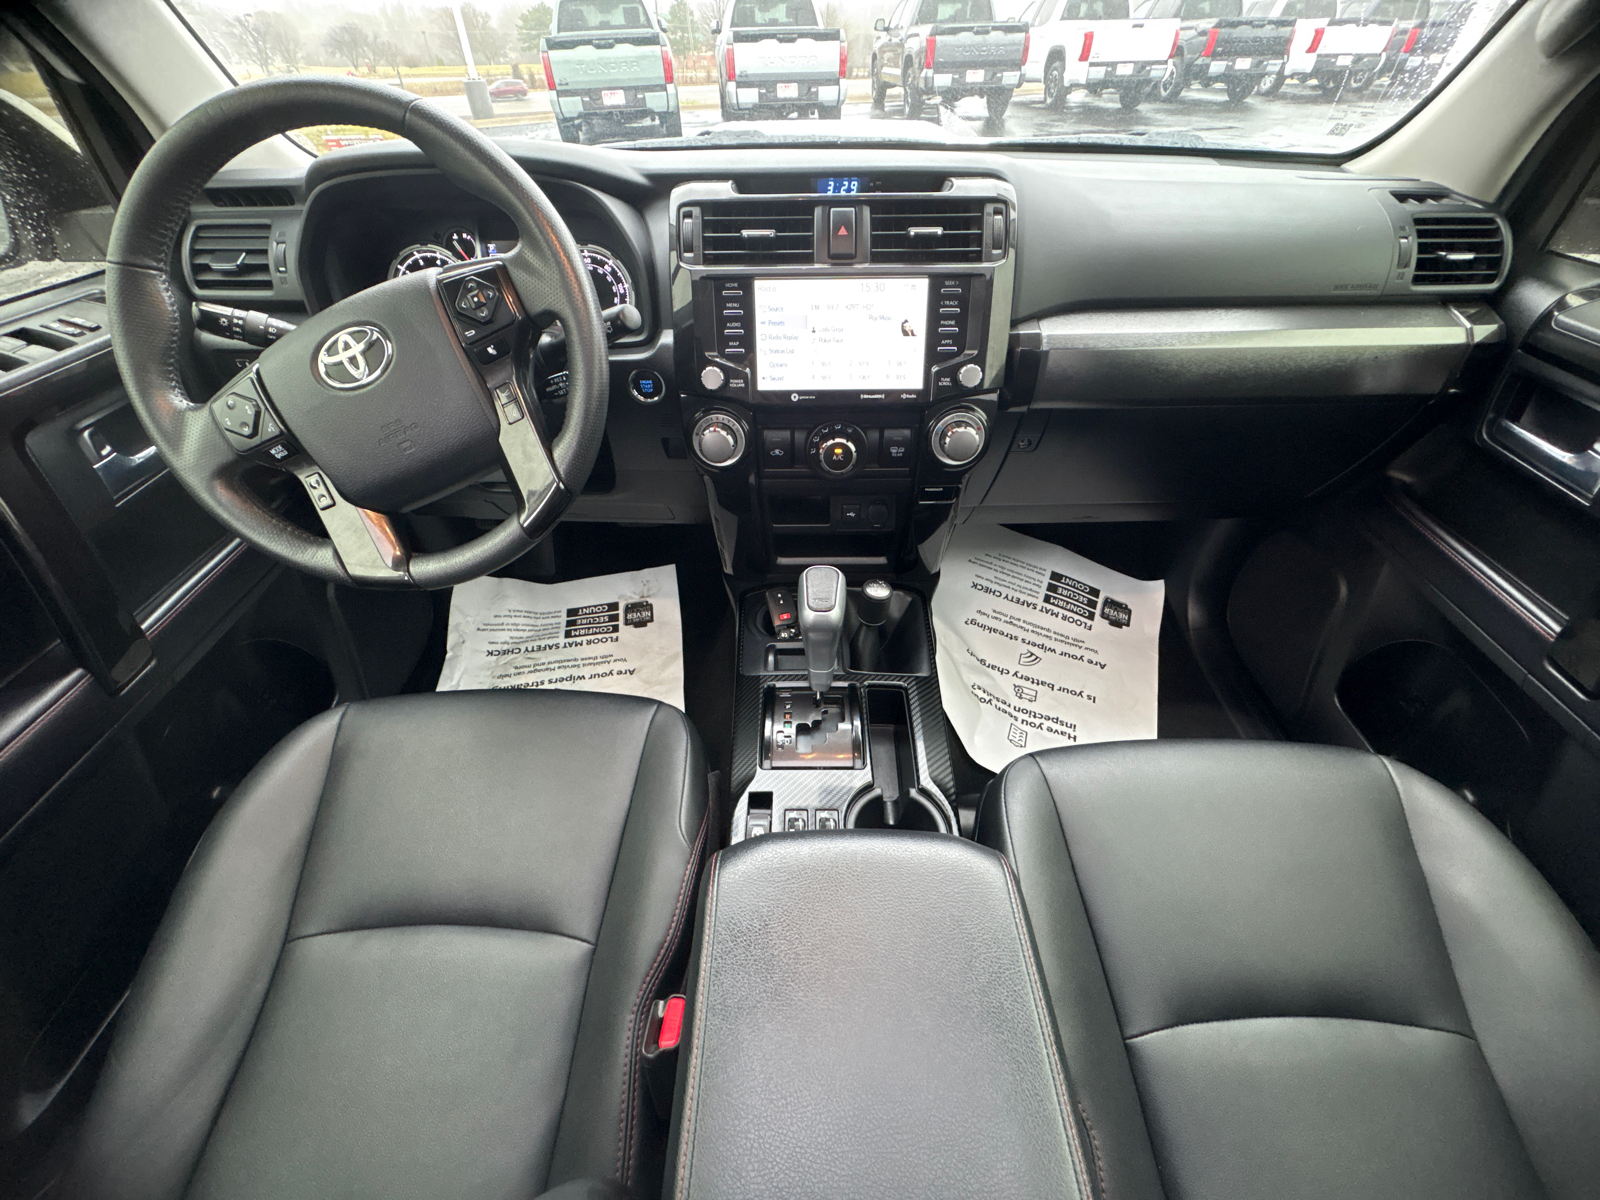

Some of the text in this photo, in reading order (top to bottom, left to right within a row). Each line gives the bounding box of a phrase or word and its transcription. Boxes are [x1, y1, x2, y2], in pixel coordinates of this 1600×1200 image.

[574, 61, 640, 74] TUNDRA
[826, 181, 858, 194] 3:29
[860, 282, 885, 292] 1530
[971, 581, 1002, 598] CHECK
[1060, 576, 1090, 592] COUNT
[1003, 593, 1038, 610] SAFETY
[1056, 587, 1088, 604] SECURE
[577, 605, 608, 615] COUNT
[1039, 605, 1059, 618] MAT
[1050, 596, 1089, 616] CONFIRM
[576, 615, 609, 624] SECURE
[626, 610, 651, 619] NEVER
[976, 609, 990, 619] help
[991, 608, 1008, 618] more.
[1009, 615, 1021, 623] and
[1104, 606, 1128, 620] NEVER
[1002, 620, 1029, 633] Manager
[1022, 619, 1052, 634] questions
[1061, 613, 1092, 631] FLOOR
[571, 626, 613, 636] CONFIRM
[1031, 629, 1052, 640] Service
[1053, 630, 1070, 642] these
[486, 636, 619, 657] FLOOR MAT SAFETY CHECK
[964, 618, 1107, 670] Are your wipers streaking?
[1054, 637, 1083, 650] Assistant
[1084, 647, 1098, 655] Your
[547, 657, 579, 667] questions
[557, 661, 580, 670] Service
[582, 660, 612, 669] Assistant
[526, 665, 556, 675] Manager
[588, 669, 614, 680] your
[548, 674, 586, 686] wipers
[1012, 671, 1055, 691] battery
[1056, 686, 1084, 699] your
[1086, 694, 1096, 704] Is
[971, 682, 1077, 732] inspection results?
[994, 704, 1018, 722] seen
[1021, 719, 1044, 731] you
[1046, 726, 1077, 742] Have
